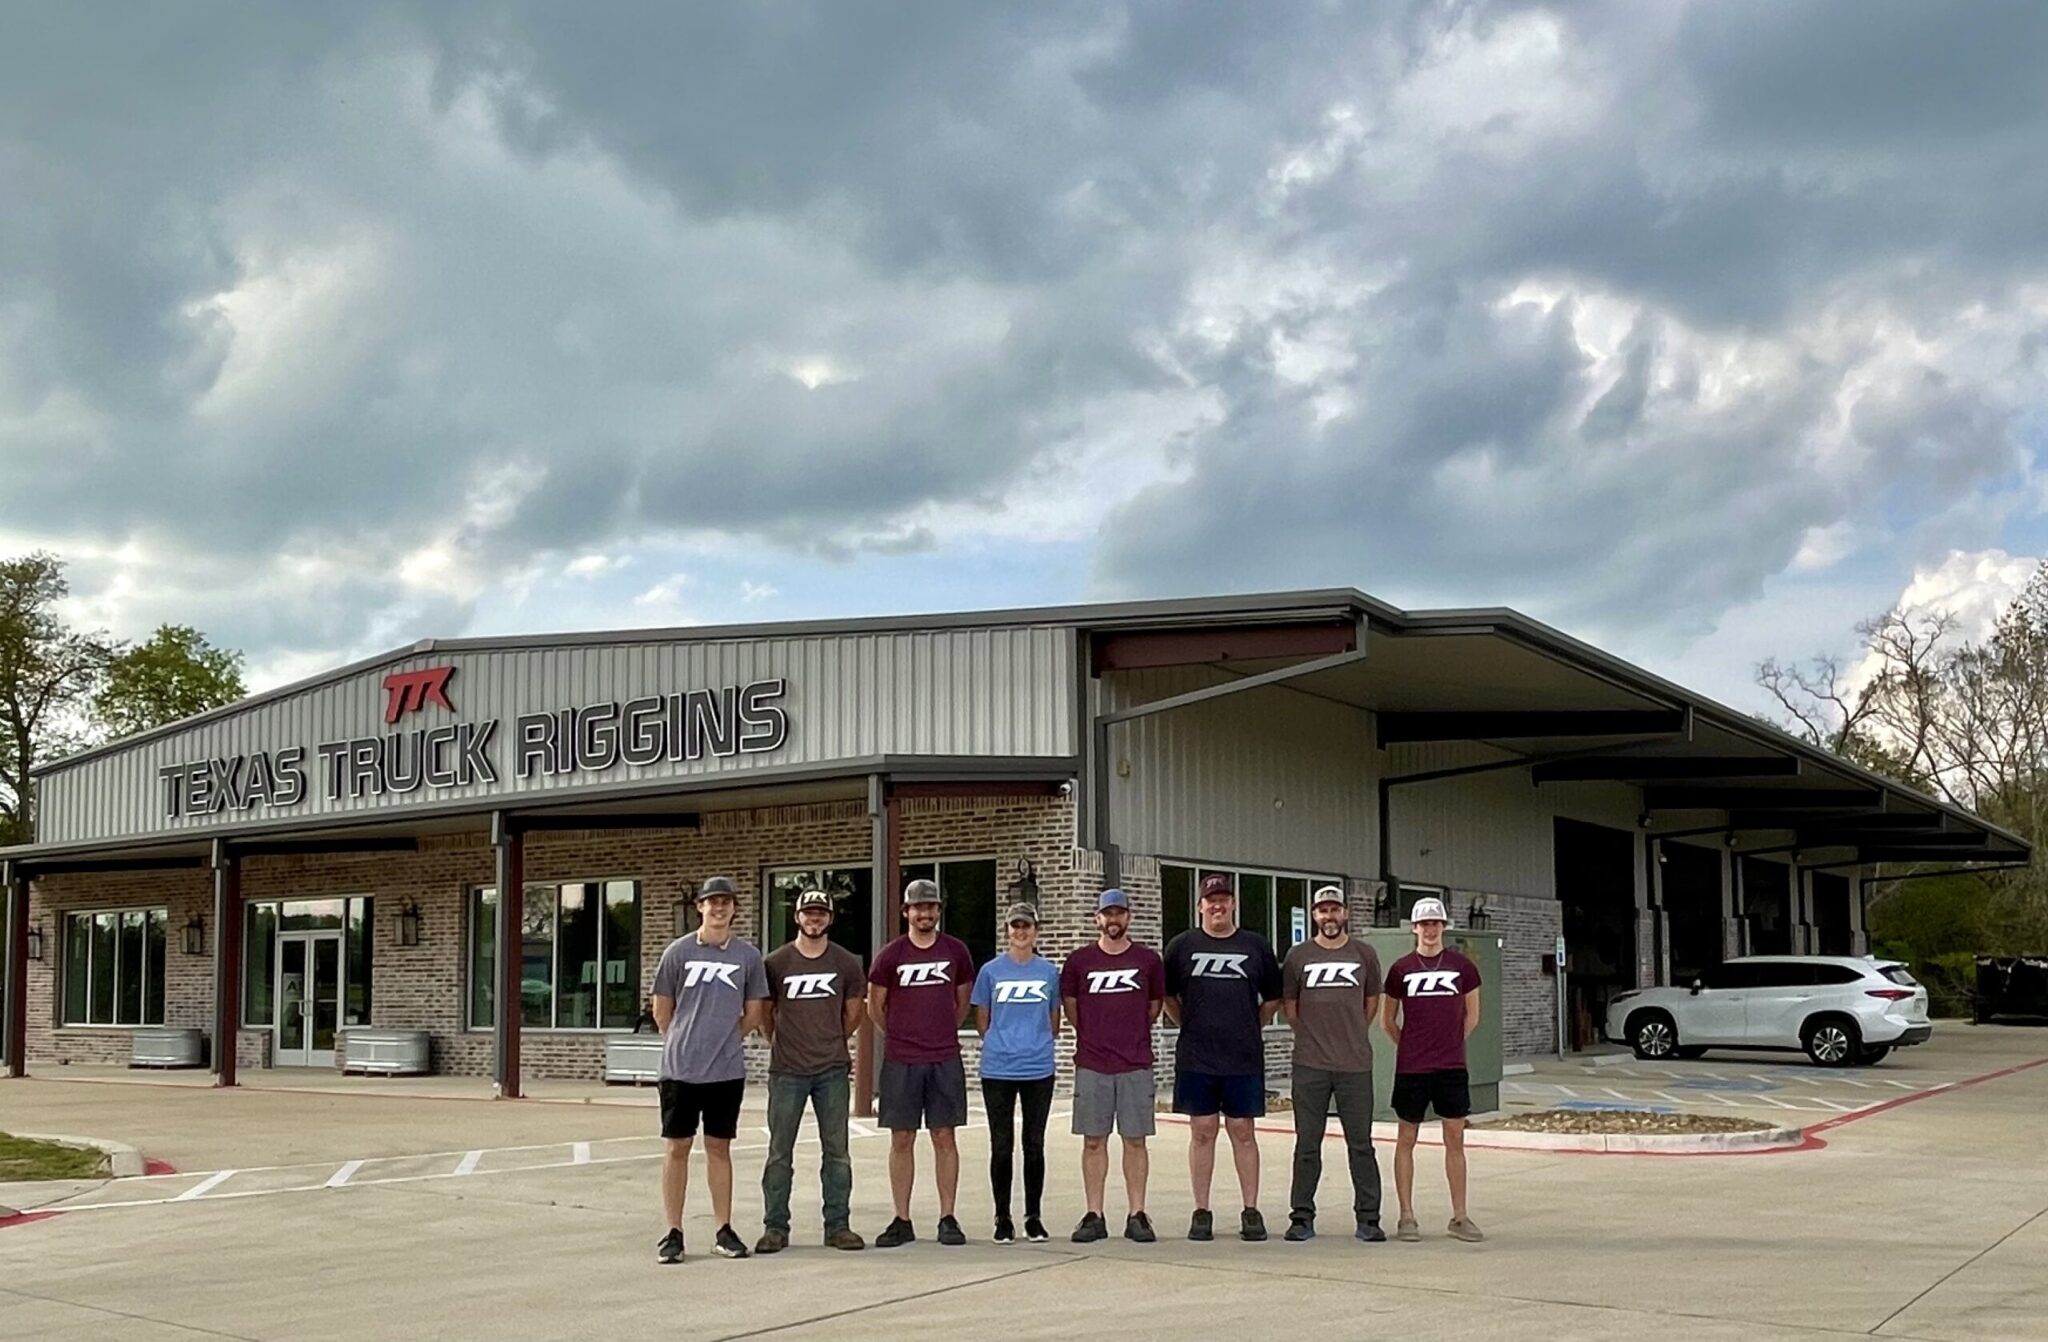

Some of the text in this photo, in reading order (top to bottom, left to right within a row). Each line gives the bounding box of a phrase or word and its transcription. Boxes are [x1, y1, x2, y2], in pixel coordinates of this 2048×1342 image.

[160, 678, 787, 818] TEXAS TRUCK RIGGINS
